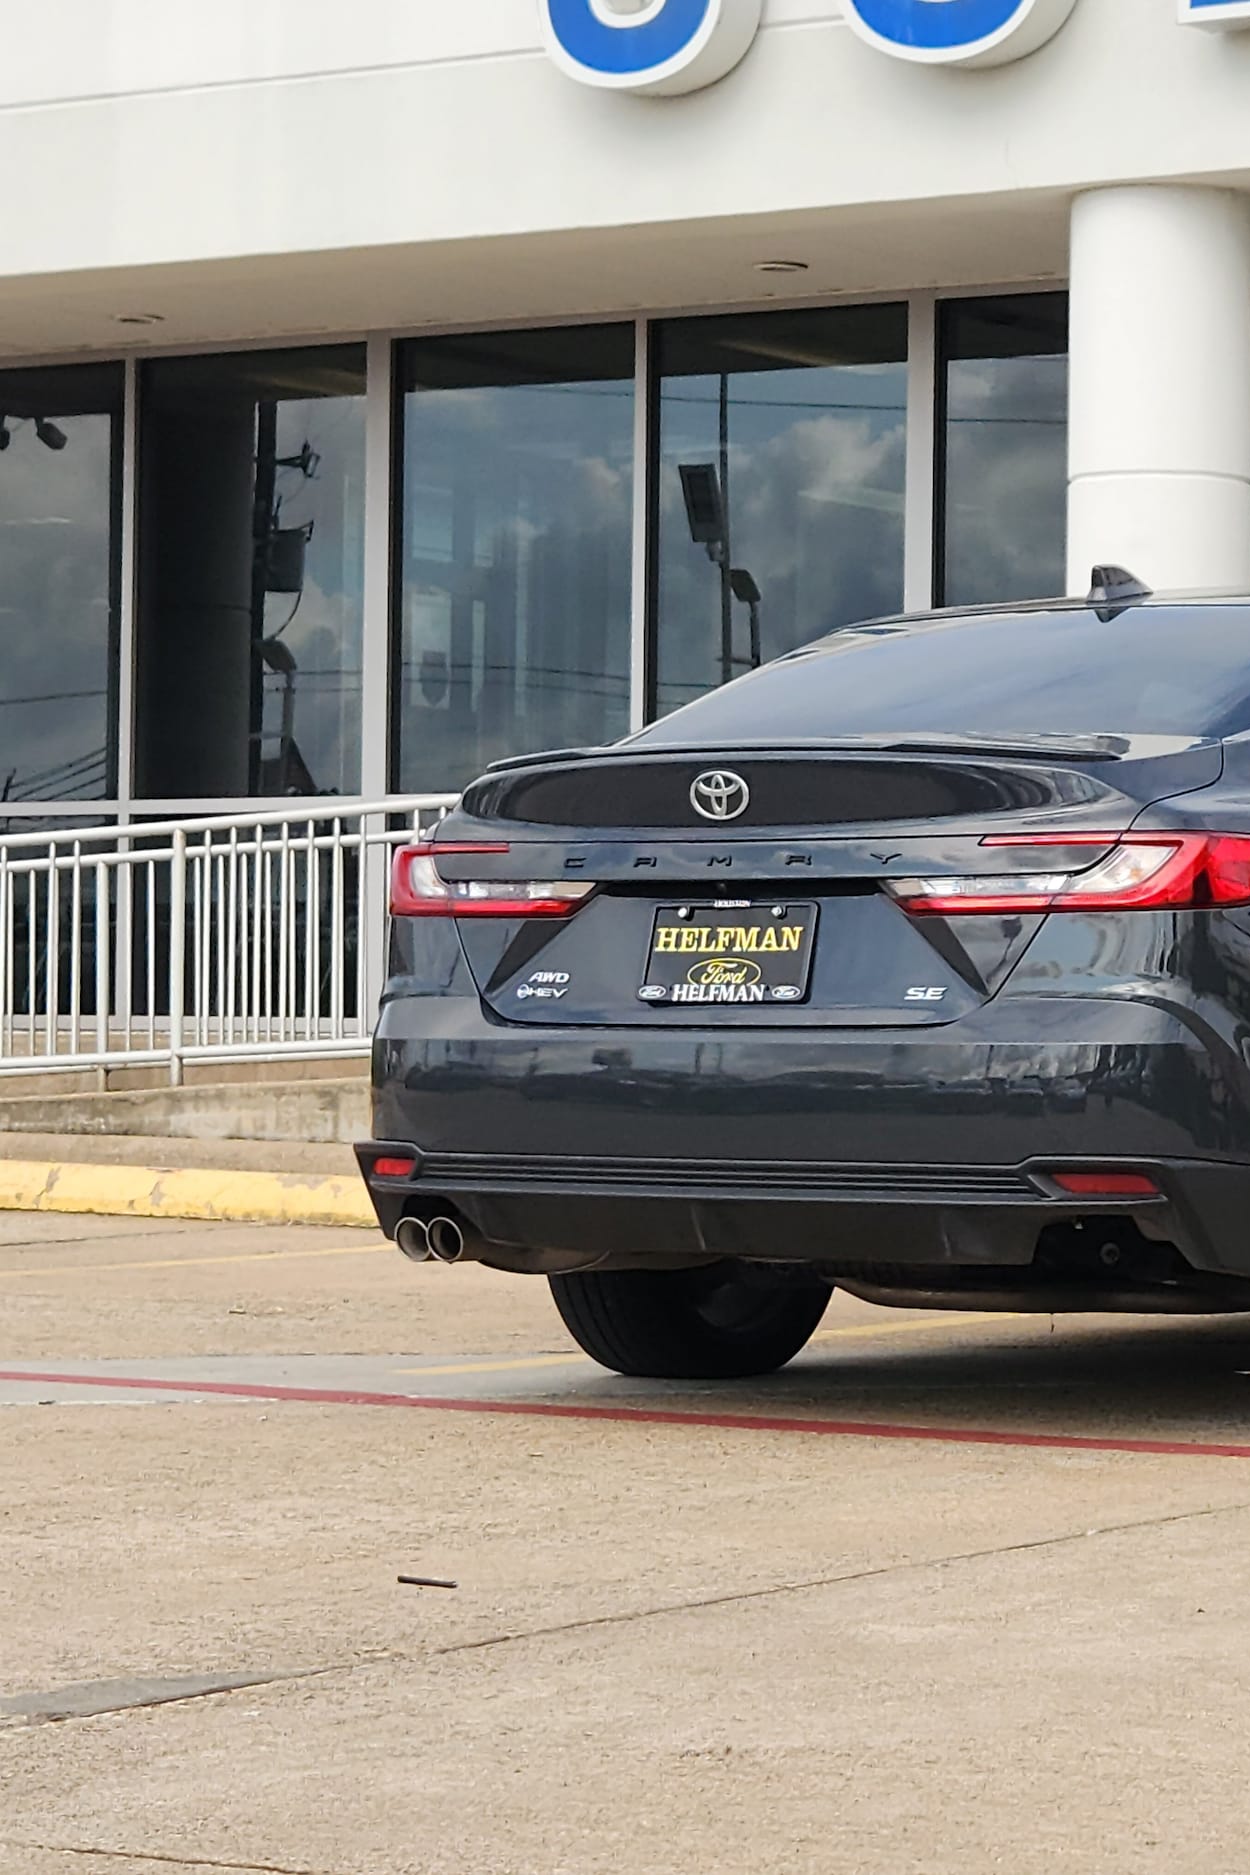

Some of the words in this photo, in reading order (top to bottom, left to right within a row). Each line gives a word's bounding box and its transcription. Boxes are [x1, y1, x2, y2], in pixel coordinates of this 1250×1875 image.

[564, 852, 903, 869] CAMRY
[654, 926, 804, 952] HELFMAN
[528, 971, 570, 983] AWD
[700, 961, 748, 985] Ford
[671, 984, 766, 1002] HELFMAN
[903, 983, 948, 1000] SE
